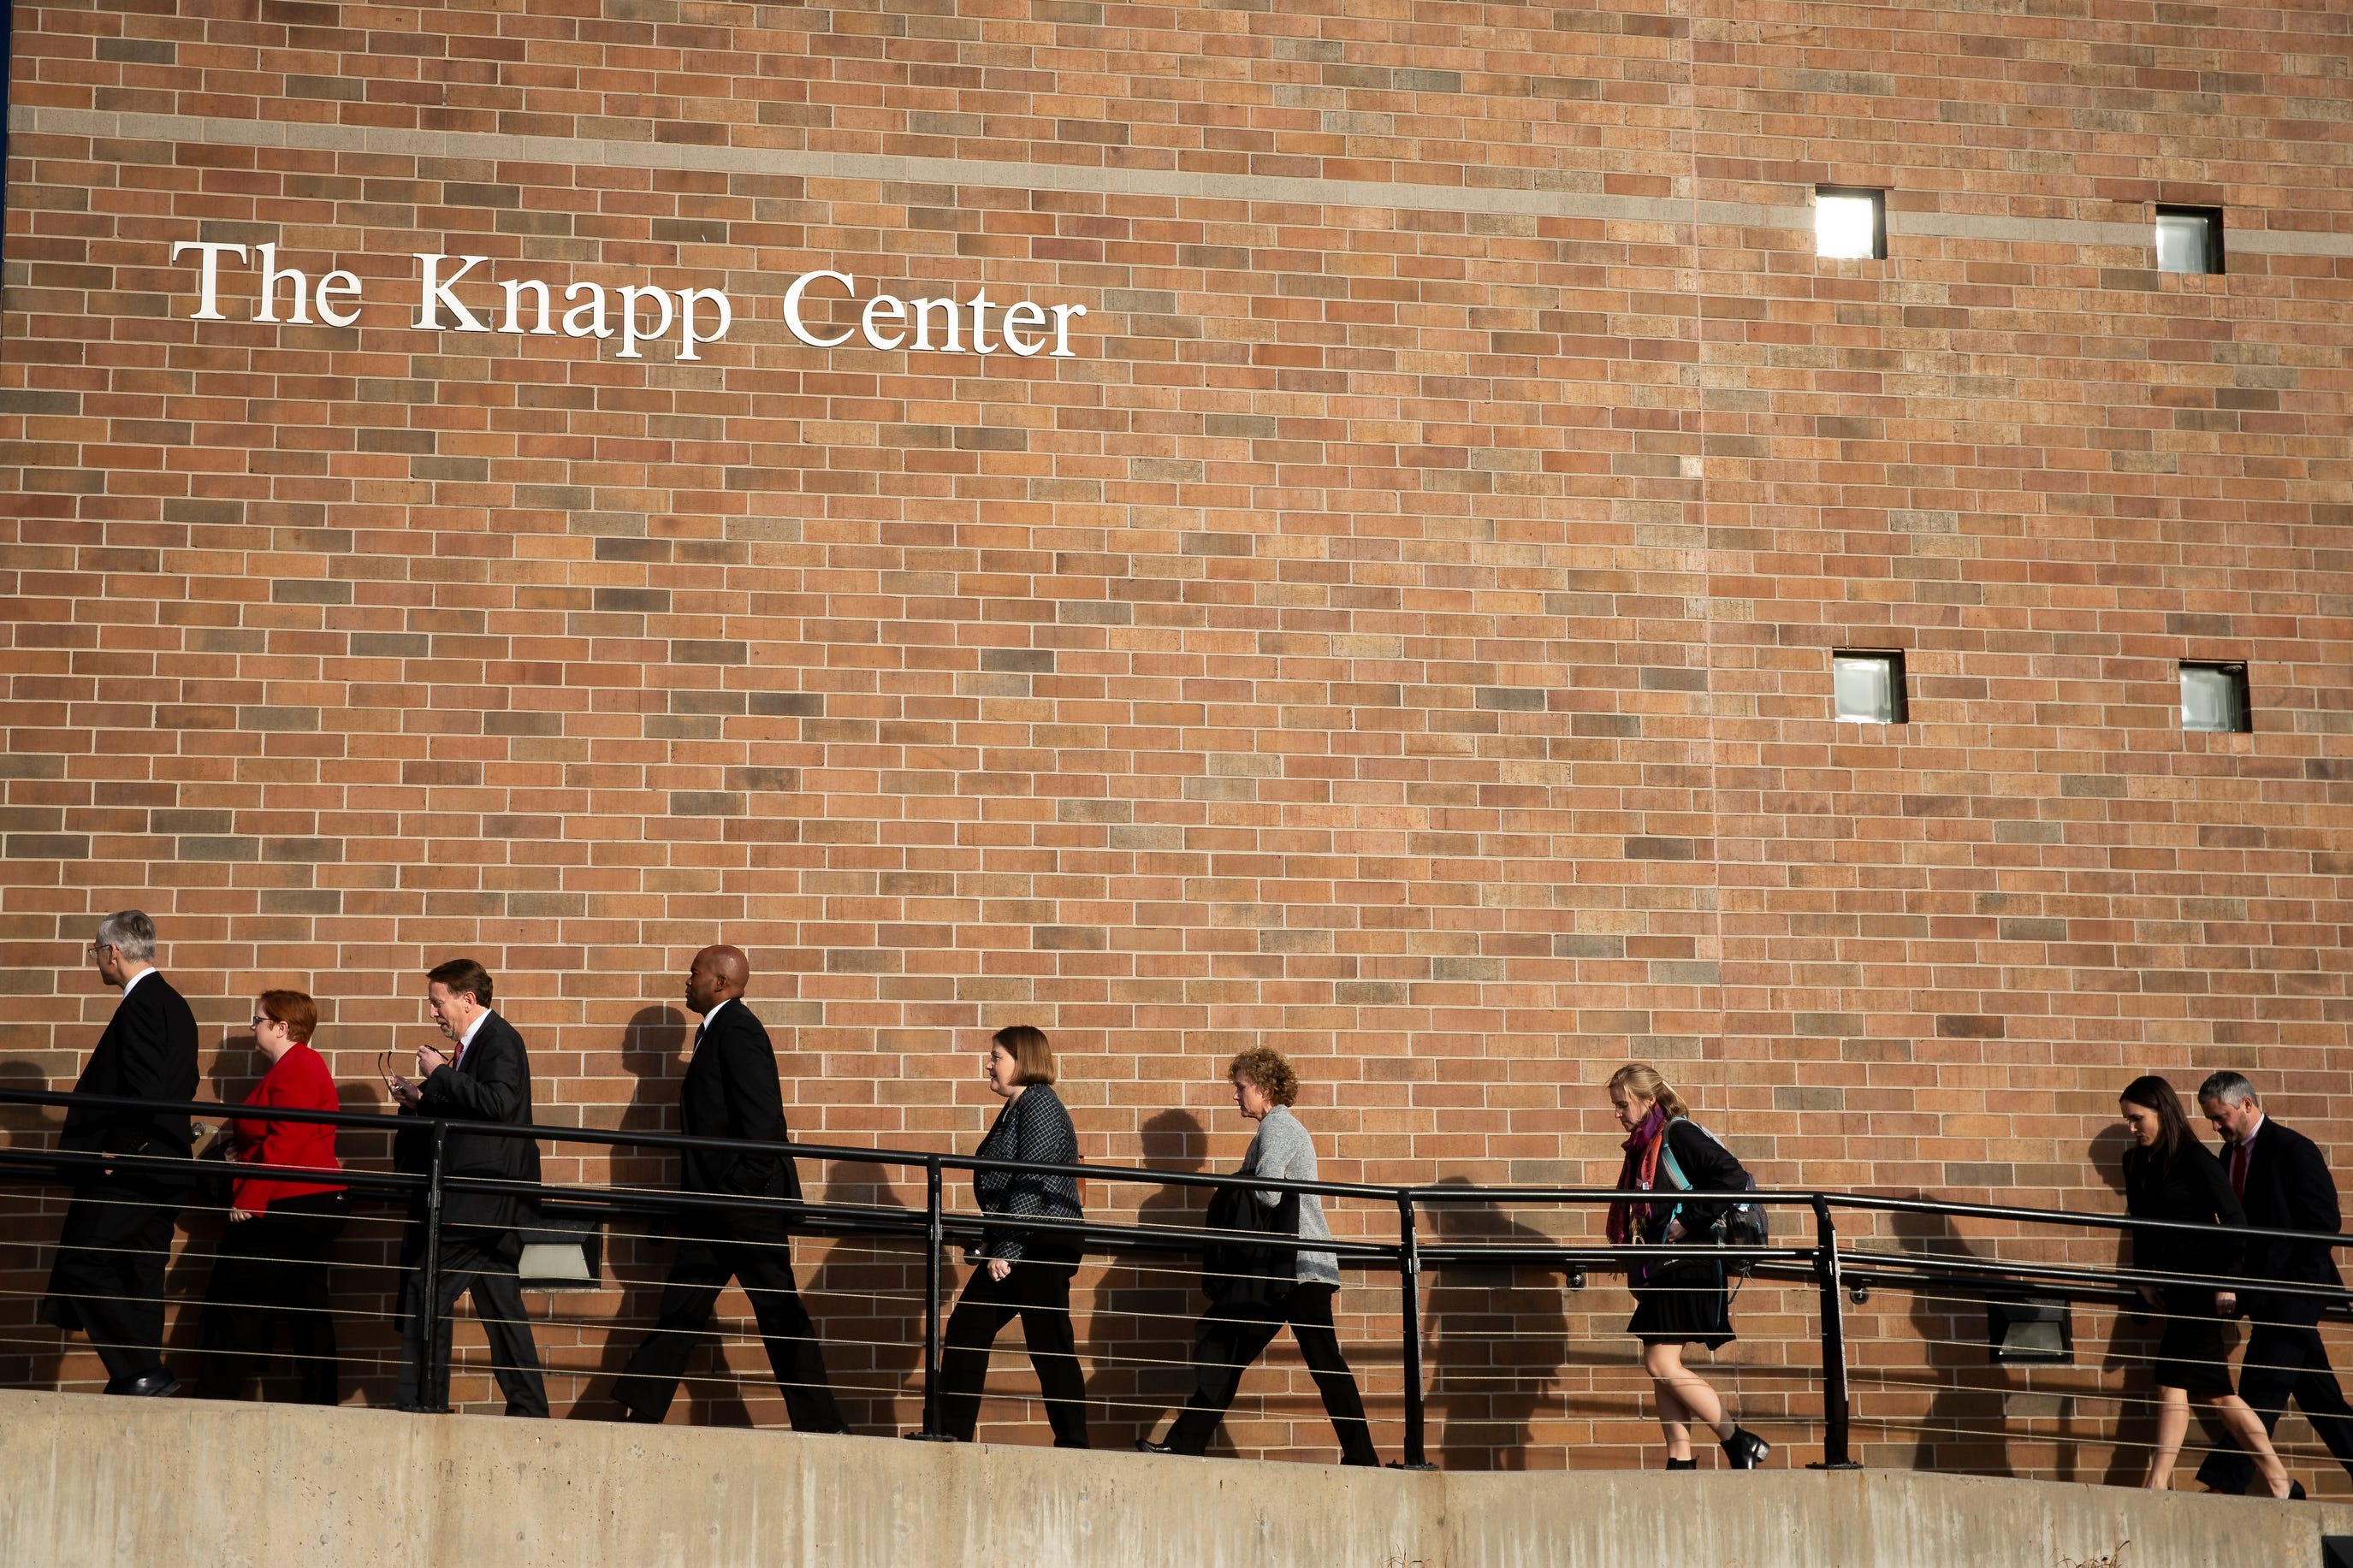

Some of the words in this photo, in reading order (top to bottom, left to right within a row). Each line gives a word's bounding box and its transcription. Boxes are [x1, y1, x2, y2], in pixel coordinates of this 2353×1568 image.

[172, 240, 363, 328] The
[410, 252, 732, 361] Knapp
[783, 269, 1088, 358] Center
